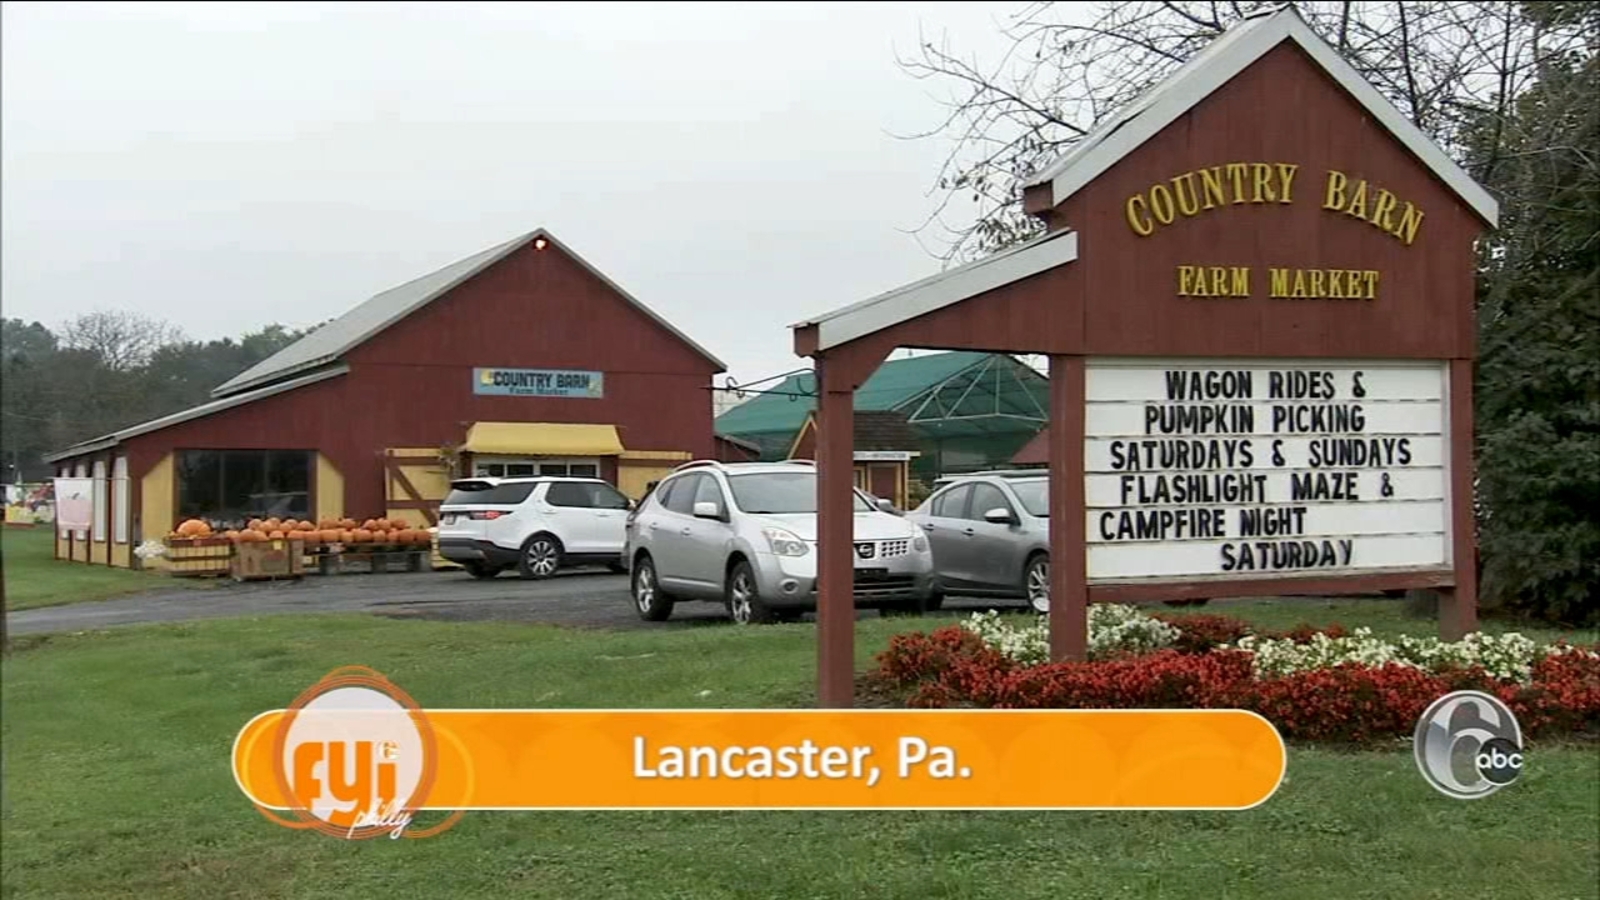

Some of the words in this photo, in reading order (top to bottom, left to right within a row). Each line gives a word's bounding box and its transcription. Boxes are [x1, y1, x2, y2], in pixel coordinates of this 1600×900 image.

[1126, 161, 1298, 237] COUNTRY
[1322, 169, 1425, 246] BARN
[1177, 265, 1250, 298] FARM
[1270, 268, 1380, 301] MARKET
[493, 370, 552, 388] COUNTRY
[556, 374, 590, 389] BARN
[1165, 370, 1252, 400] WAGON
[1269, 370, 1335, 399] RIDES
[1352, 371, 1366, 398] &
[1145, 404, 1253, 434] PUMPKIN
[1273, 405, 1366, 433] PICKING
[1110, 440, 1253, 471] SATURDAYS
[1271, 440, 1286, 467] &
[1309, 438, 1411, 468] SUNDAYS
[1121, 474, 1267, 505] FLASHLIGHT
[1291, 472, 1358, 501] MAZE
[1380, 472, 1394, 497] &
[1100, 508, 1225, 540] CAMPFIRE
[1240, 507, 1307, 537] NIGHT
[1221, 540, 1353, 571] SATURDAY
